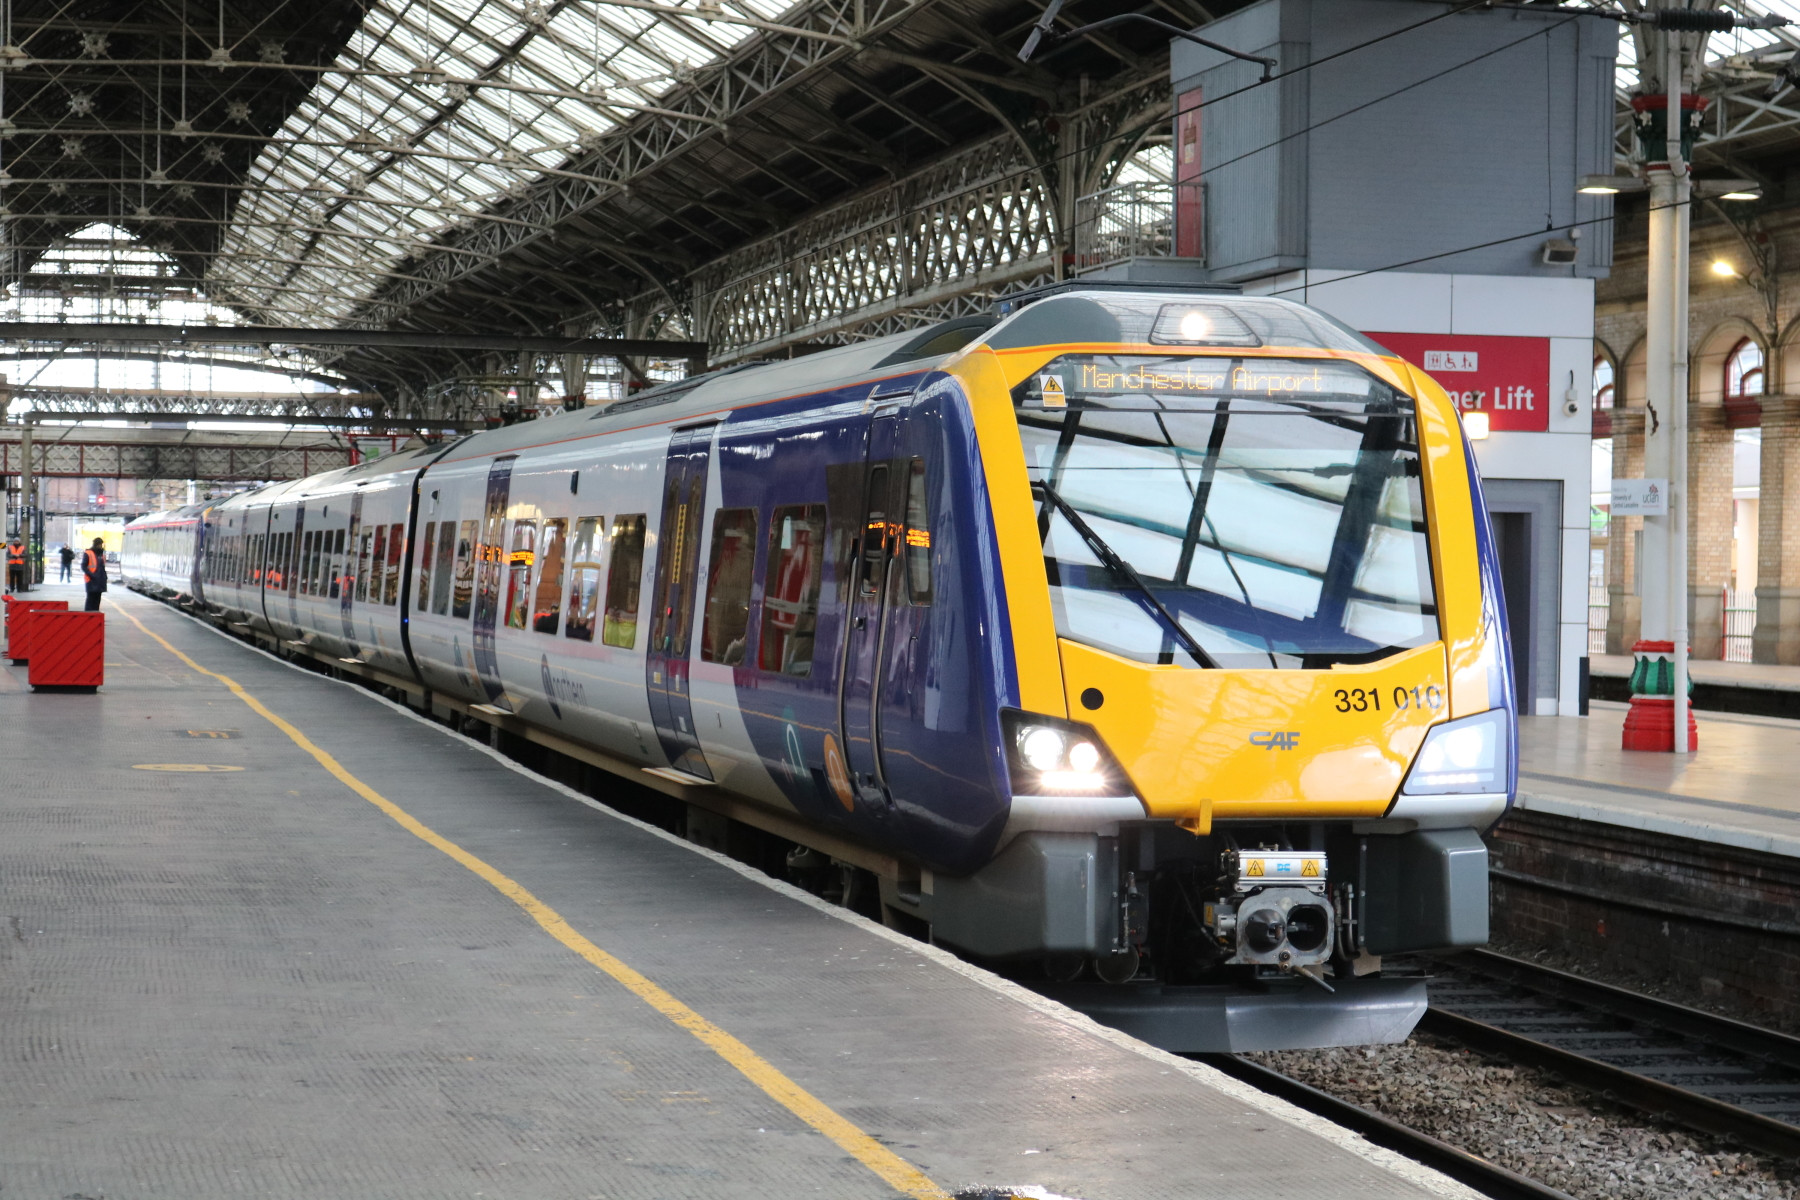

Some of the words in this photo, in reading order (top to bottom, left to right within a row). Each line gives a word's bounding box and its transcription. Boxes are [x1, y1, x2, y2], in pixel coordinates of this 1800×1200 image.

[1082, 364, 1224, 391] Manchester
[1232, 367, 1322, 396] Airport
[1494, 386, 1535, 410] Lift
[1334, 688, 1381, 713] 331
[1393, 685, 1441, 710] 010
[1249, 731, 1300, 750] CAF
